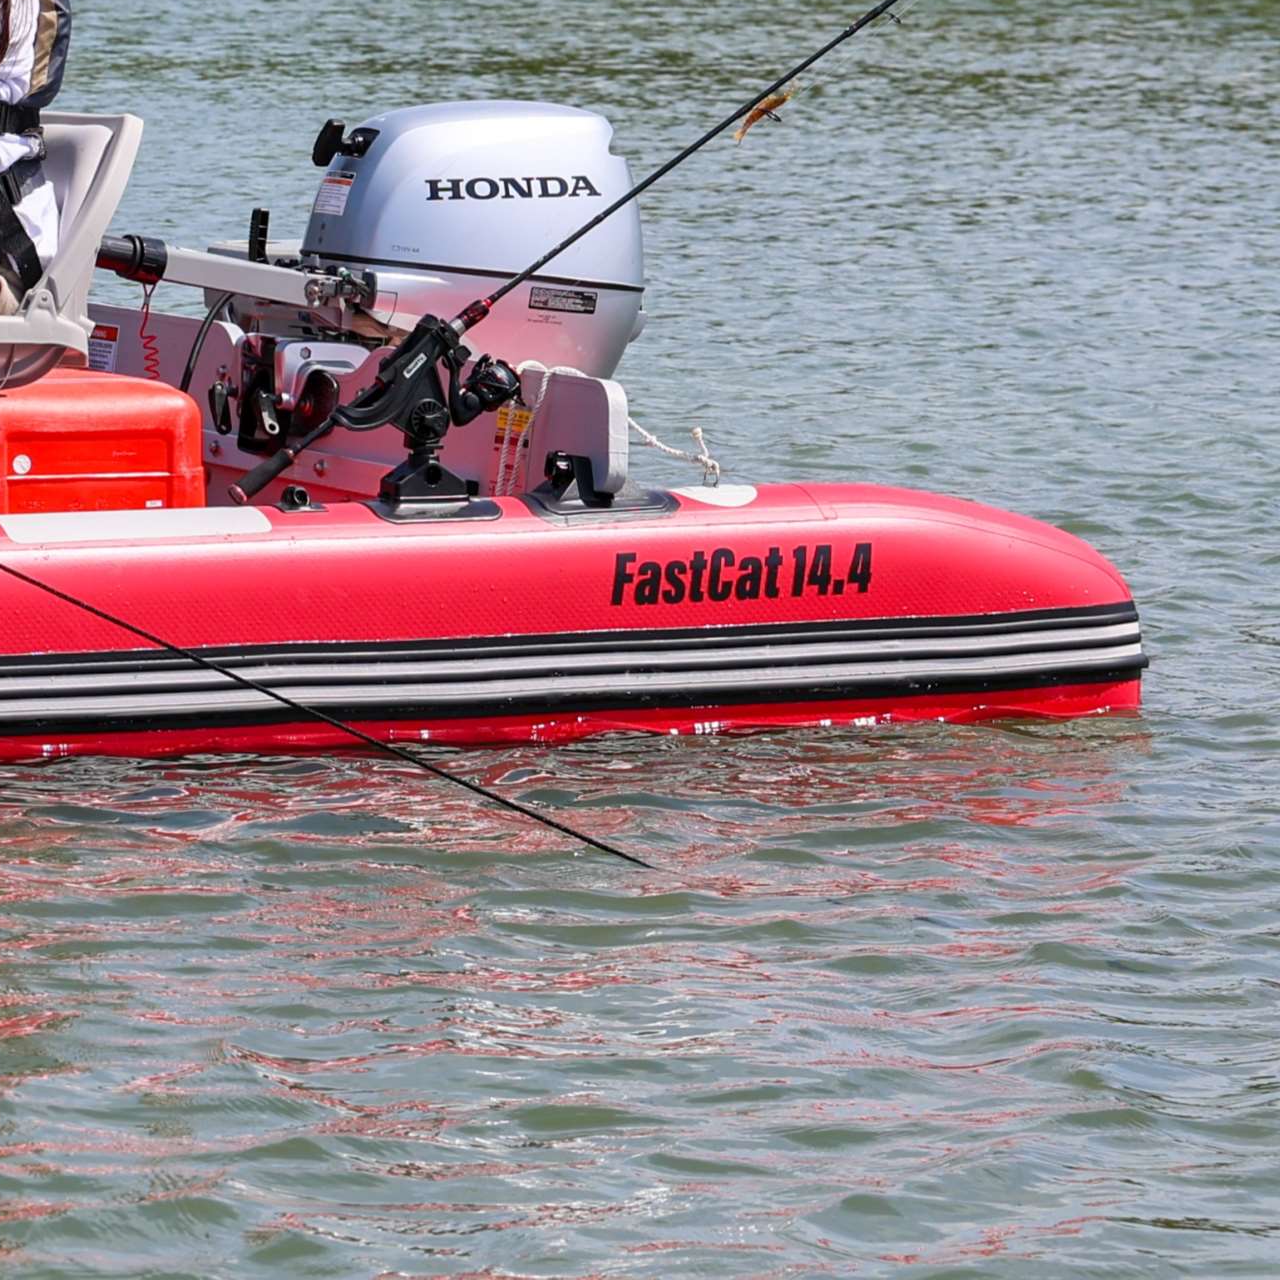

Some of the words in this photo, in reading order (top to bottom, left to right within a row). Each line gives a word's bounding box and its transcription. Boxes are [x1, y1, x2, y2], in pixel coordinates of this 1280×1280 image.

[424, 175, 602, 201] HONDA
[611, 547, 782, 605] FastCat
[791, 543, 872, 597] 14.4
